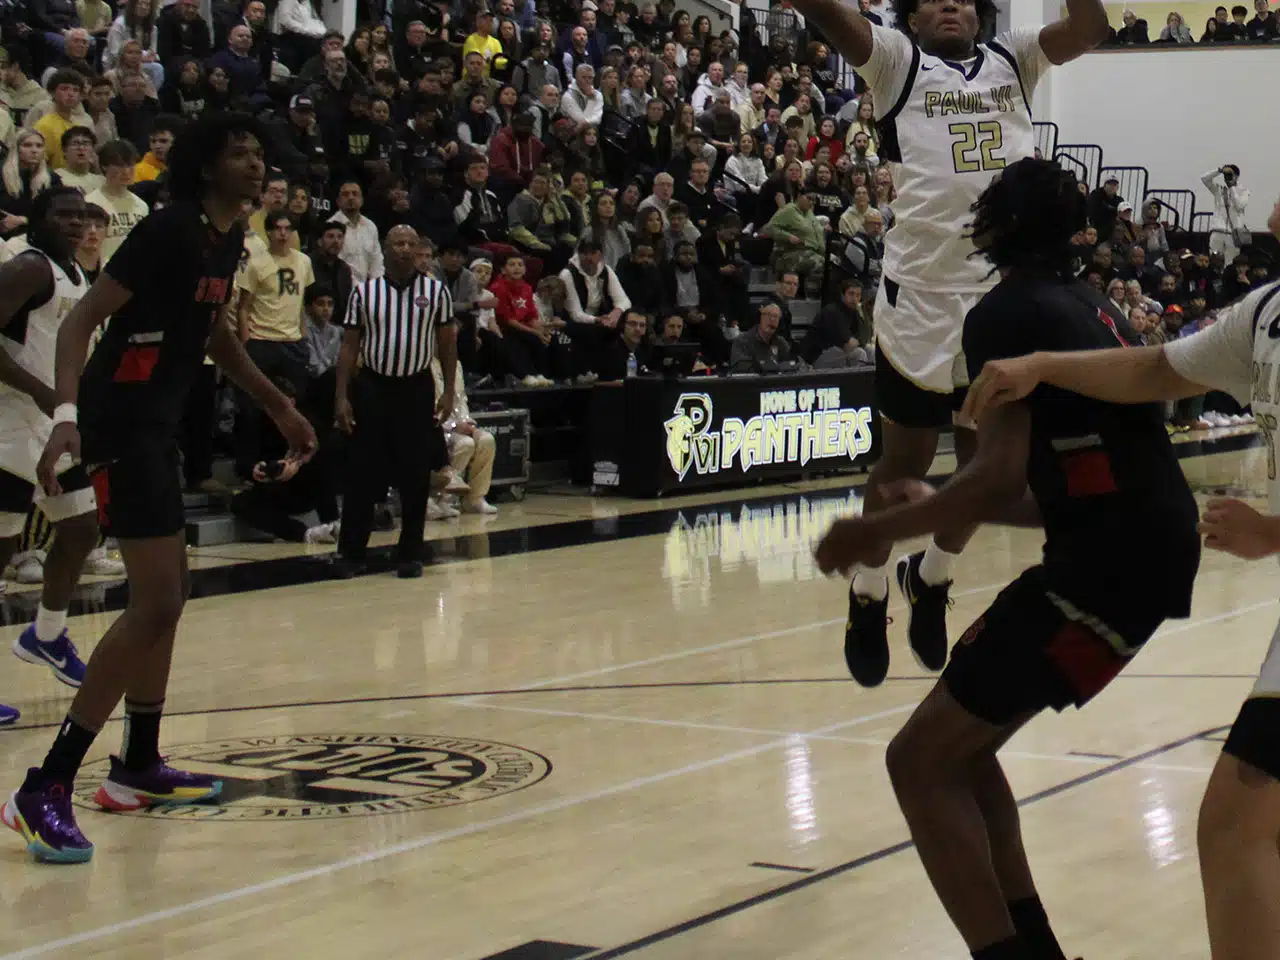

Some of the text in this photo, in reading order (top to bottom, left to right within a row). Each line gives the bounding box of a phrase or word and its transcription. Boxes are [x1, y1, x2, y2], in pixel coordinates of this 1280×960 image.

[924, 90, 990, 118] PAUL
[948, 120, 1006, 174] 22
[760, 387, 840, 415] HOME OF THE
[721, 407, 873, 472] PANTHERS
